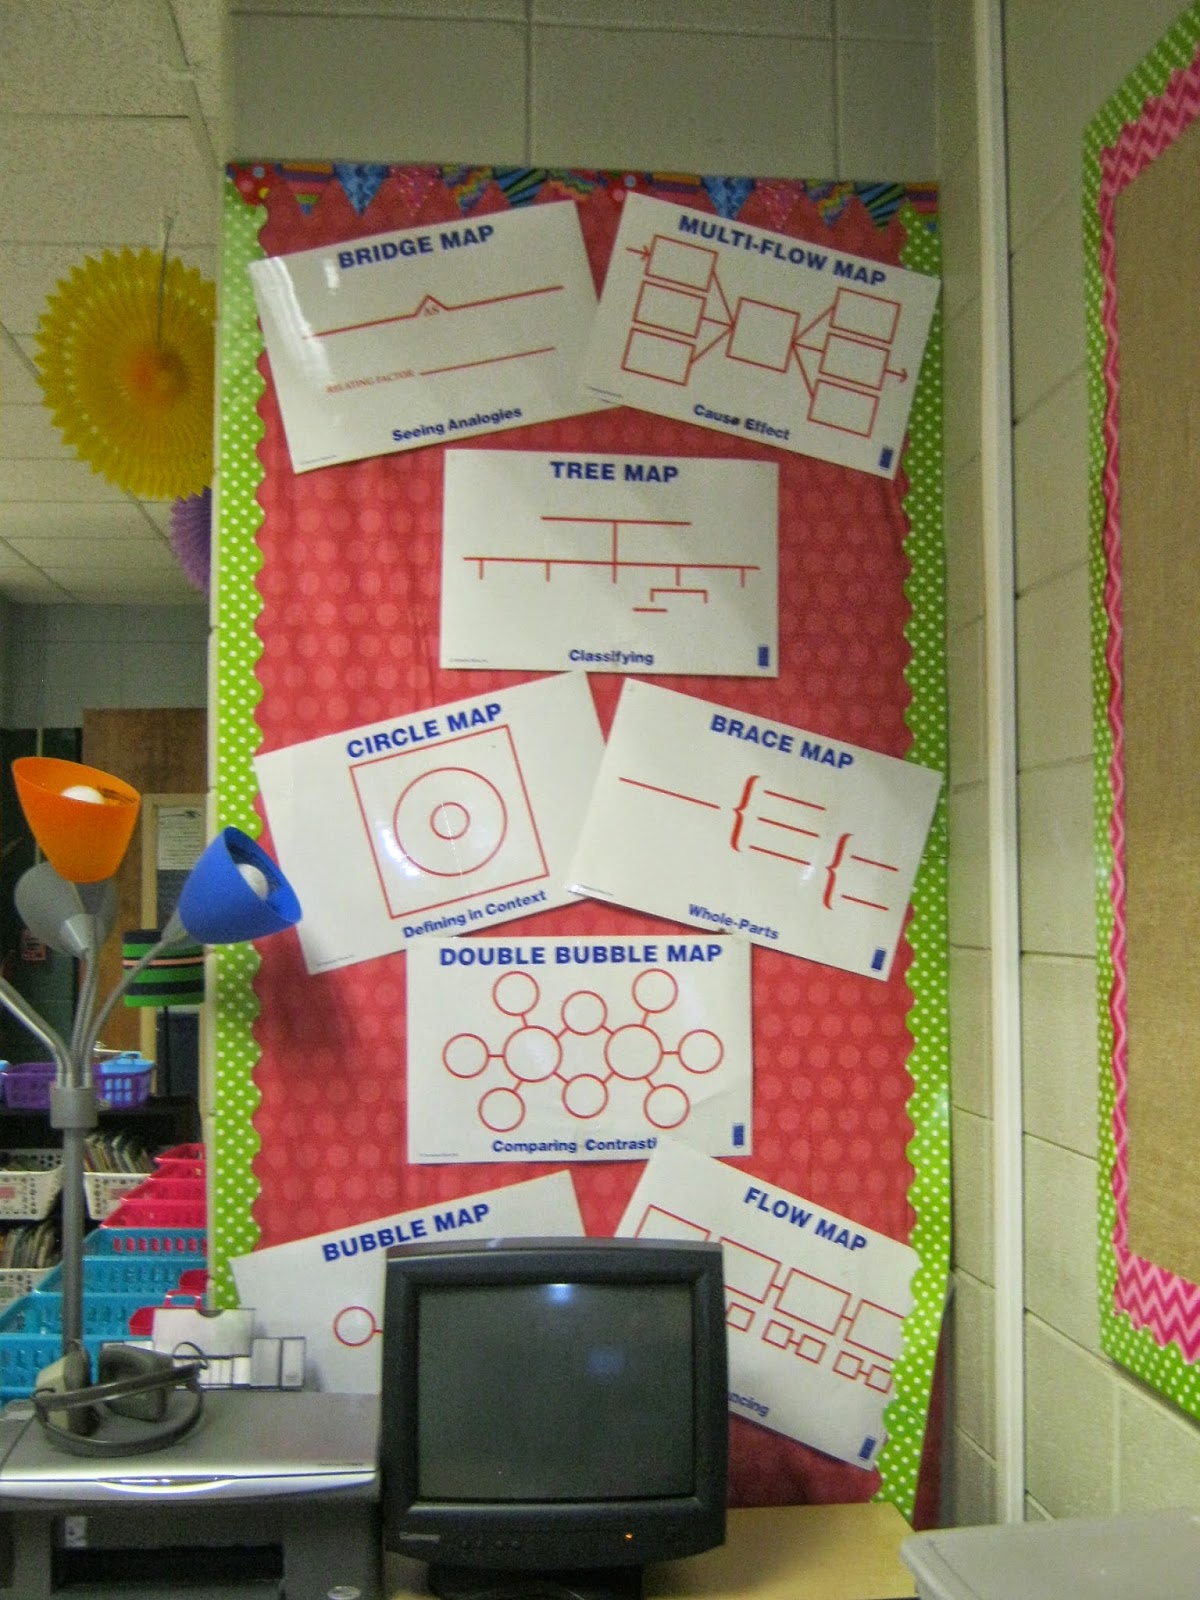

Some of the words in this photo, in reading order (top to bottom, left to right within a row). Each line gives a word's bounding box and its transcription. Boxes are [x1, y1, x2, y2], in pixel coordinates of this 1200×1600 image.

[338, 236, 433, 269] BRIDGE
[440, 225, 494, 251] MAP
[678, 215, 827, 271] MULTI-FLOW
[833, 260, 886, 286] MAP
[392, 425, 445, 443] Seeing
[448, 409, 522, 430] Analogies
[693, 403, 740, 426] Cause
[745, 417, 790, 441] Effect
[550, 461, 615, 481] TREE
[624, 464, 678, 483] MAP
[568, 649, 655, 666] Classifying
[347, 719, 440, 758] CIRCLE
[447, 702, 502, 731] MAP
[710, 714, 794, 753] BRACE
[800, 741, 853, 769] MAP
[403, 915, 467, 938] Defining
[468, 909, 484, 920] in
[485, 890, 547, 916] Context
[688, 904, 778, 939] Whole-Parts
[440, 947, 544, 966] DOUBLE
[555, 945, 656, 965] BUBBLE
[667, 943, 722, 962] MAP
[492, 1138, 577, 1154] Comparing
[585, 1138, 656, 1152] Contrasti
[322, 1219, 428, 1263] BUBBLE
[434, 1204, 489, 1232] MAP
[744, 1186, 811, 1228] FLOW
[814, 1218, 867, 1251] MAP
